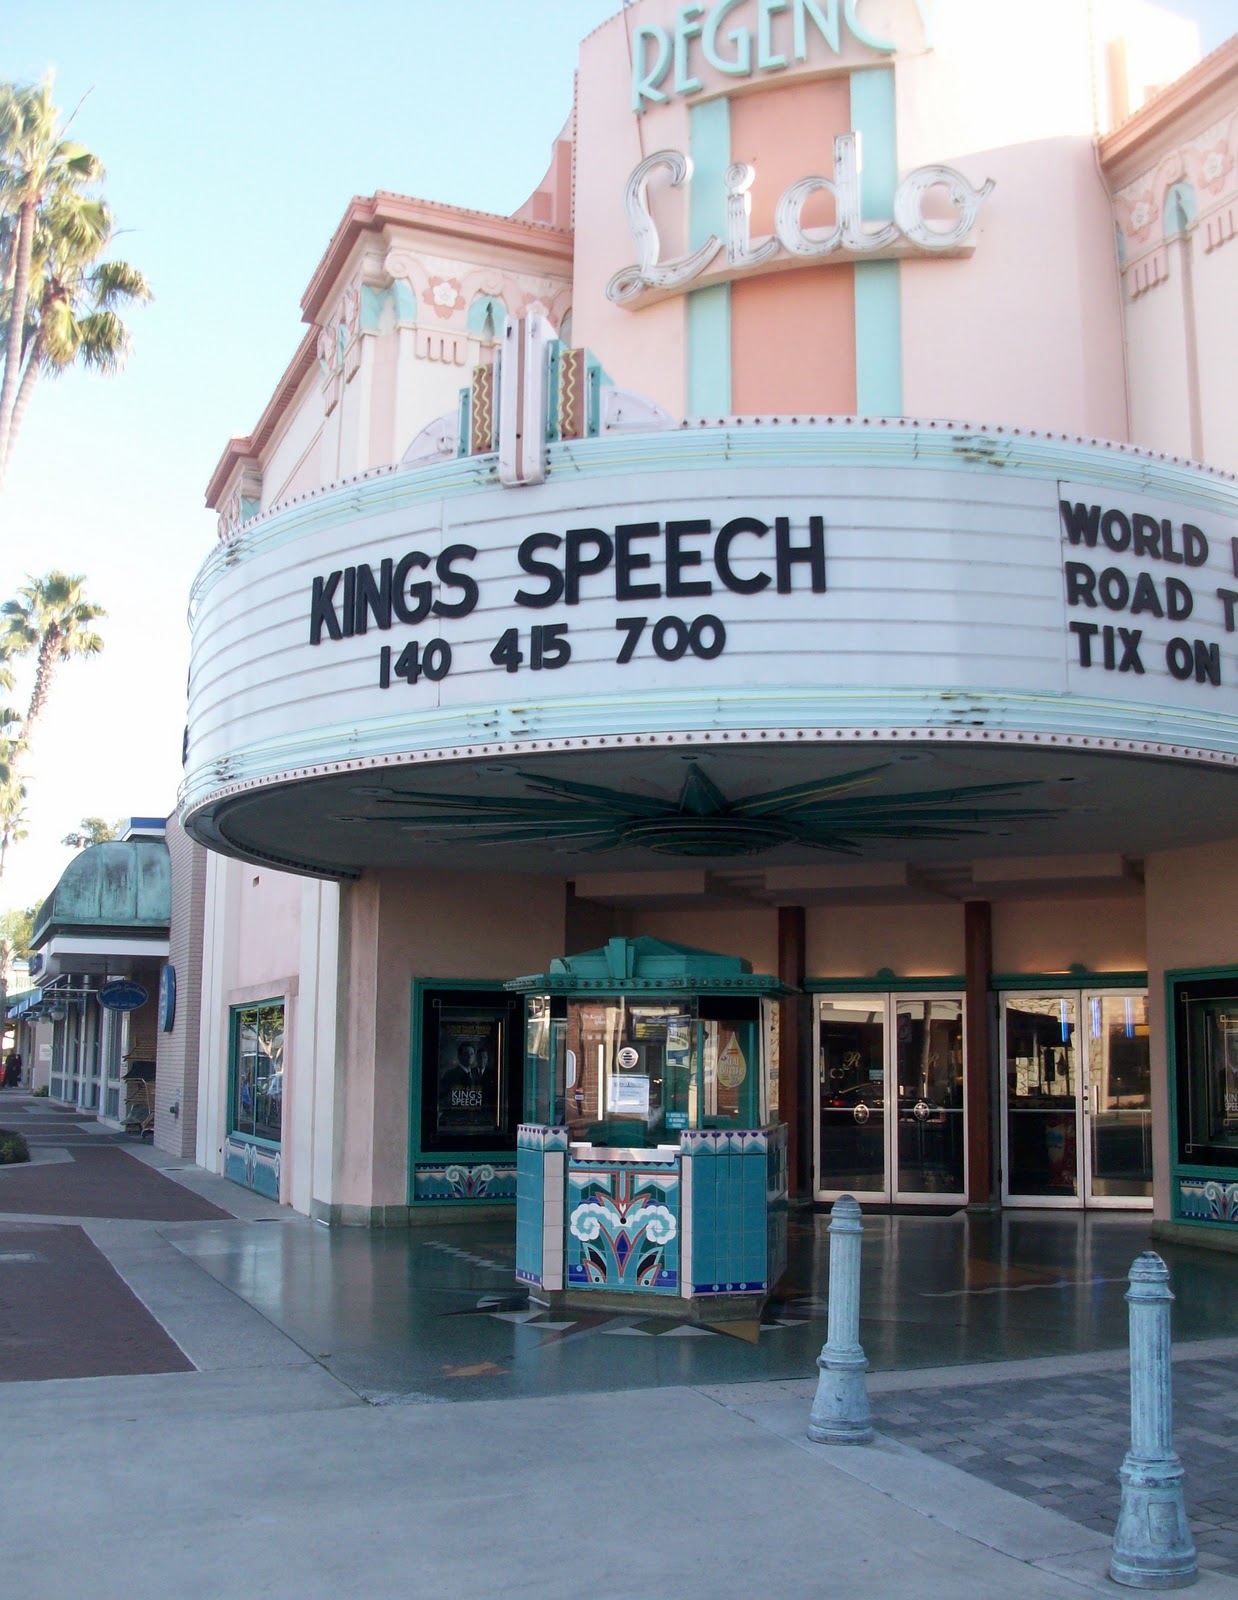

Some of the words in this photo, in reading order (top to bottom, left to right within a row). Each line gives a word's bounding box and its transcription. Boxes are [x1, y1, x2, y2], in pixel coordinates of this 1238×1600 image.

[606, 131, 997, 302] Lido
[1059, 500, 1209, 568] WORLD
[309, 543, 479, 645] KINGS
[514, 516, 827, 609] SPEECH
[1065, 561, 1194, 621] ROAD
[379, 637, 452, 689] 140
[489, 622, 572, 672] 415
[615, 615, 727, 662] 700
[1069, 621, 1146, 675] TIX
[1165, 636, 1222, 687] ON
[451, 1090, 483, 1099] KING'S
[451, 1098, 482, 1106] SPEECH
